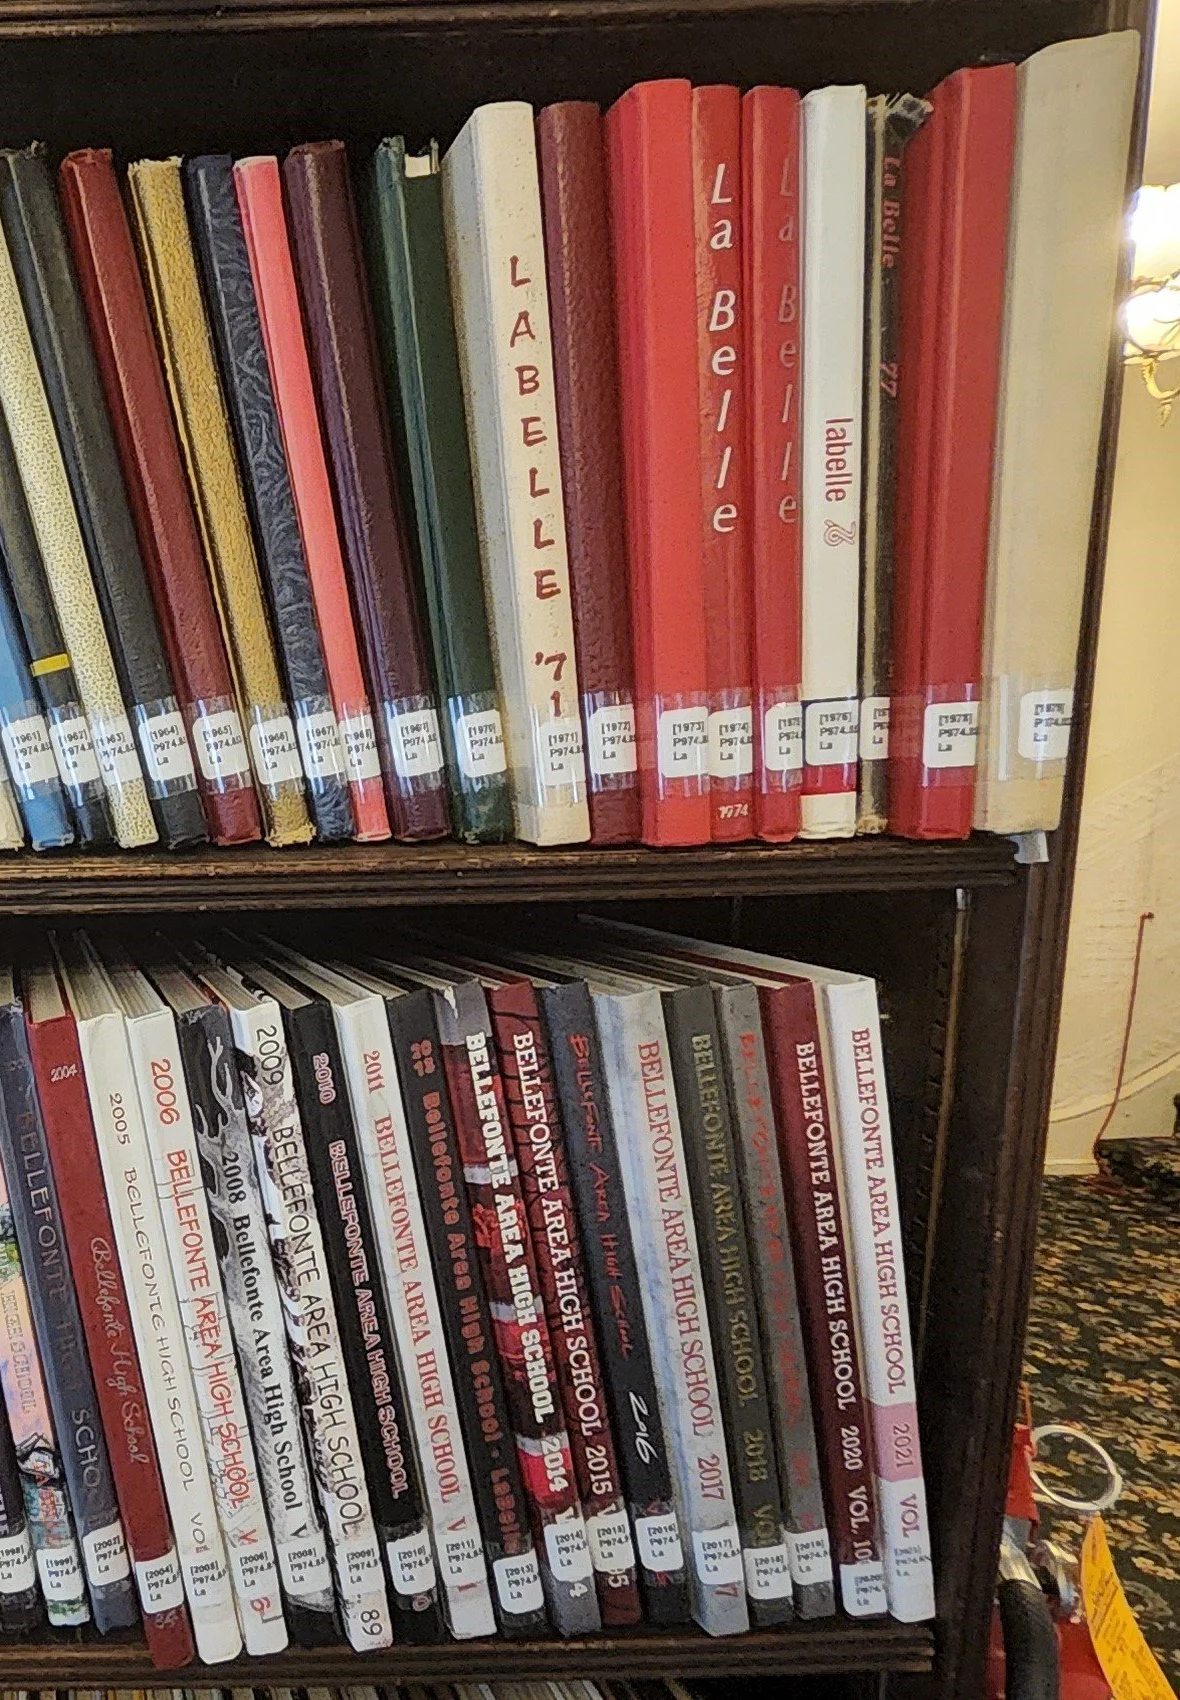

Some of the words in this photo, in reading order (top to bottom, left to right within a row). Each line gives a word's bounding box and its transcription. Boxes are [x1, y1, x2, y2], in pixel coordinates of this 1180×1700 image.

[880, 201, 900, 269] Belle
[508, 255, 563, 600] LABELLE
[709, 289, 736, 533] Belle
[825, 417, 853, 503] labelle
[548, 731, 578, 746] [1971]
[718, 804, 749, 819] 1974
[50, 1064, 77, 1082] 2004
[256, 1024, 285, 1086] 2009
[312, 1052, 337, 1105] 2010
[363, 1050, 386, 1094] 2011
[151, 1059, 181, 1125] 2006
[466, 1031, 512, 1190] BELLEFONTE
[512, 1030, 560, 1195] BELLEFONTE
[638, 1040, 682, 1203] BELLEFONTE
[691, 1033, 730, 1180] BELLEFONTE
[795, 1041, 831, 1186] BELLEFONTE
[851, 1027, 885, 1171] BELLEFONTE
[221, 1151, 247, 1206] 2008
[272, 1124, 321, 1288] BELLEFONTE
[374, 1113, 419, 1274] BELLEFONTE
[866, 1173, 891, 1237] AREA
[167, 1149, 210, 1294] BELLEFONTE
[328, 1140, 369, 1287] BELLEFONTE
[494, 1193, 524, 1264] AREA
[541, 1198, 571, 1266] AREA
[662, 1206, 691, 1276] AREA
[710, 1183, 737, 1244] AREA
[813, 1190, 843, 1252] AREA
[108, 1092, 131, 1145] 2005
[124, 1167, 166, 1330] BELLEFONTE
[156, 1336, 178, 1392] HIGH
[169, 1396, 195, 1492] SCHOOL
[232, 1213, 264, 1322] Bellefonte
[507, 1263, 537, 1327] HIGH
[821, 1254, 847, 1316] HIGH
[873, 1240, 898, 1300] HIGH
[193, 1294, 223, 1360] AREA
[301, 1294, 332, 1358] AREA
[355, 1286, 382, 1352] AREA
[402, 1279, 432, 1346] AREA
[553, 1270, 585, 1333] HIGH
[672, 1273, 701, 1336] HIGH
[253, 1328, 275, 1380] Area
[367, 1348, 393, 1405] HIGH
[415, 1348, 445, 1410] HIGH
[519, 1329, 553, 1424] SCHOOL
[728, 1309, 758, 1401] SCHOOL
[828, 1317, 856, 1412] SCHOOL
[880, 1303, 907, 1394] SCHOOL
[208, 1362, 235, 1418] HIGH
[262, 1384, 285, 1437] High
[314, 1362, 347, 1430] HIGH
[565, 1336, 603, 1437] SCHOOL
[680, 1339, 715, 1438] SCHOOL
[219, 1422, 250, 1510] SCHOOL
[274, 1440, 304, 1511] School
[378, 1405, 408, 1500] SCHOOL
[428, 1413, 462, 1504] SCHOOL
[541, 1433, 569, 1493] 2014
[585, 1444, 614, 1496] 2015
[697, 1454, 726, 1502] 2017
[743, 1429, 768, 1483] 2018
[839, 1425, 862, 1472] 2020
[892, 1422, 914, 1469] 2021
[328, 1436, 365, 1537] SCHOOL
[899, 1493, 920, 1538] VOL
[360, 1608, 384, 1637] 89
